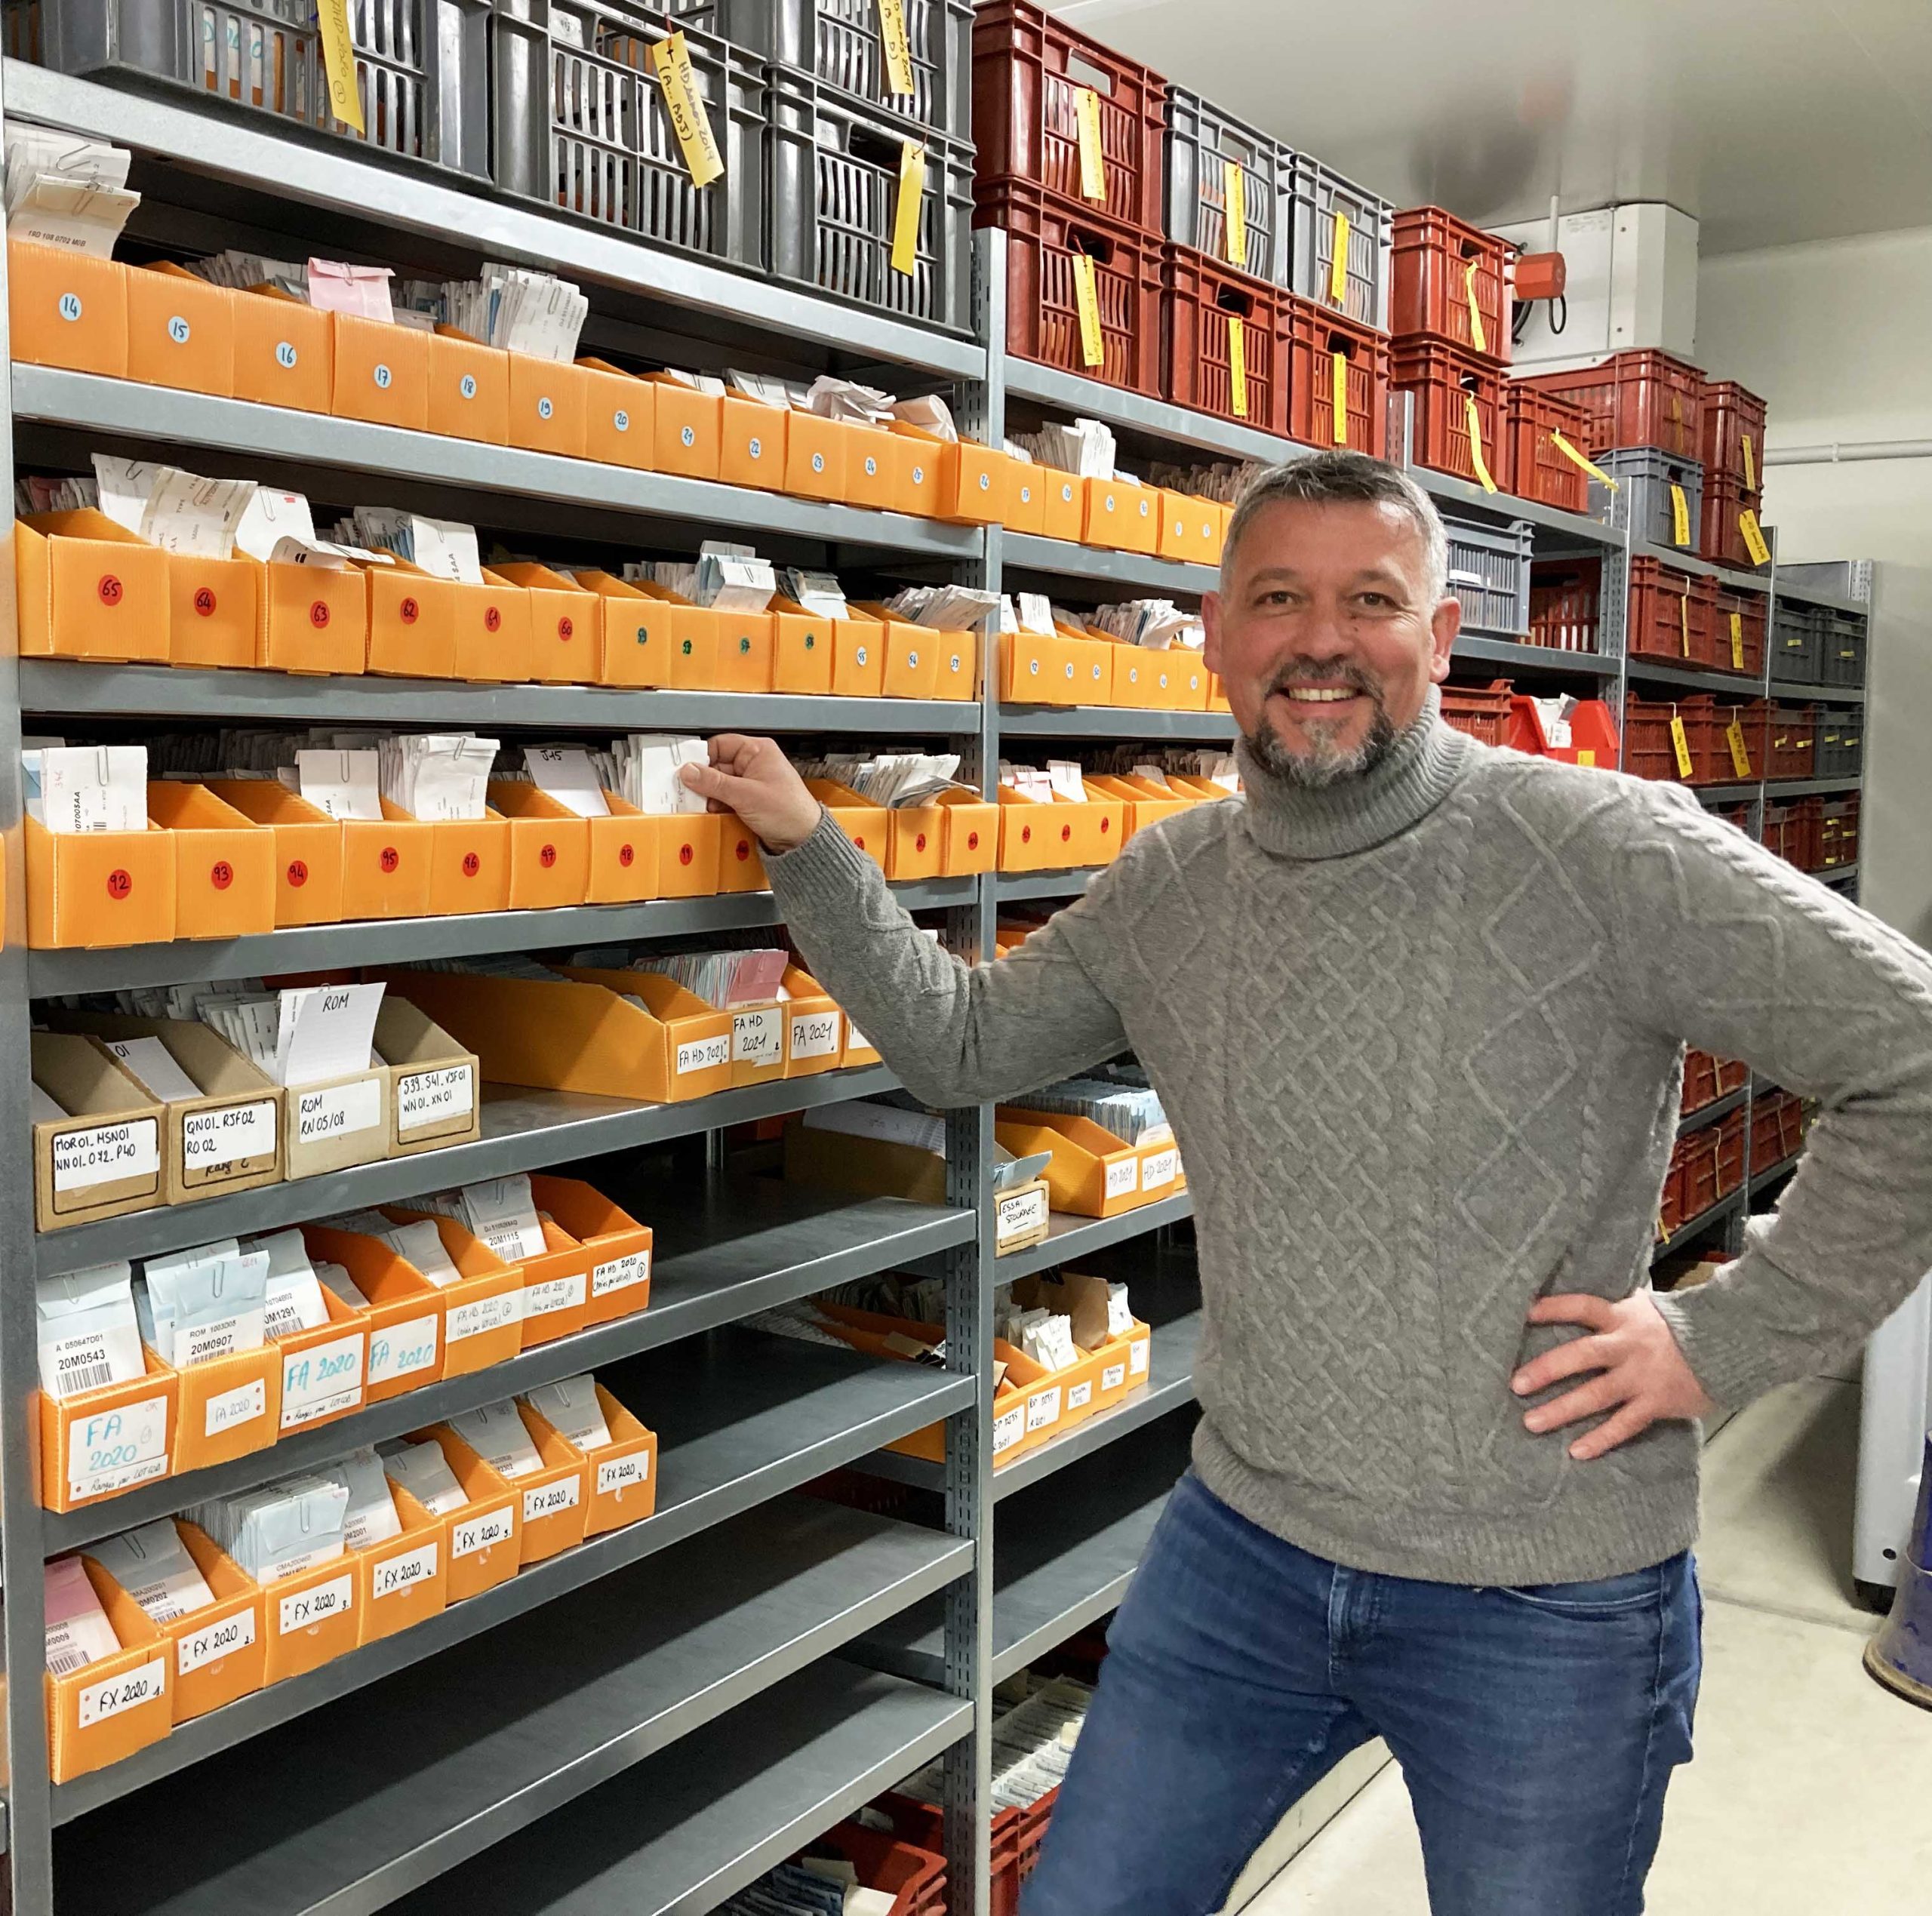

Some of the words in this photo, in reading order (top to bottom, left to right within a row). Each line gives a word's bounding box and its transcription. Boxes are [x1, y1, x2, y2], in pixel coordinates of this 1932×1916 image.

[678, 61, 690, 84] HD
[64, 296, 78, 317] 14
[173, 321, 188, 338] 15
[281, 346, 294, 364] 16
[377, 368, 389, 386] 17
[463, 378, 474, 394] 18
[540, 401, 551, 416] 19
[617, 412, 627, 426] 20
[683, 427, 693, 444] 21
[750, 441, 760, 454] 22
[814, 455, 823, 469] 23
[866, 460, 875, 473] 24
[913, 468, 922, 480] 25
[102, 580, 122, 597] 65
[196, 592, 211, 610] 64
[403, 599, 415, 618] 62
[313, 607, 328, 622] 63
[488, 609, 499, 626] 61
[561, 620, 572, 635] 60
[857, 650, 866, 662] 55
[909, 654, 917, 665] 54
[951, 658, 959, 668] 53
[382, 850, 396, 866] 95
[464, 855, 477, 869] 96
[541, 847, 555, 863] 97
[620, 848, 632, 861] 98
[681, 847, 691, 859] 99
[214, 865, 229, 881] 93
[288, 864, 305, 881] 94
[109, 874, 129, 891] 92
[322, 992, 350, 1013] ROM
[734, 1017, 746, 1032] FA
[749, 1014, 764, 1028] HD
[742, 1032, 768, 1052] 2021
[792, 1024, 807, 1047] FA
[809, 1020, 834, 1041] 2021
[679, 1050, 690, 1068] FA
[692, 1047, 705, 1063] HD
[706, 1044, 724, 1062] 2021
[301, 1094, 323, 1115] ROM
[595, 1266, 606, 1278] FA
[608, 1264, 617, 1274] HD
[621, 1257, 638, 1269] 2020
[189, 1328, 207, 1339] ROM
[190, 1334, 233, 1356] 20M0907
[58, 1349, 106, 1371] 20M0543
[369, 1339, 390, 1373] FA
[397, 1343, 434, 1369] 2020
[286, 1360, 310, 1392] FA
[315, 1352, 357, 1382] 2020
[215, 1407, 226, 1422] FA
[229, 1398, 251, 1416] 2020
[86, 1413, 122, 1447] FA
[88, 1444, 137, 1472] 2020
[606, 1468, 617, 1482] FX
[618, 1462, 635, 1478] 2020
[533, 1497, 545, 1512] FX
[546, 1489, 567, 1508] 2020
[462, 1530, 476, 1550] FX
[481, 1523, 500, 1542] 2020
[384, 1570, 398, 1589] FX
[400, 1561, 422, 1581] 2020
[294, 1600, 310, 1621] FX
[314, 1592, 336, 1612] 2020
[193, 1637, 208, 1659] FX
[213, 1624, 238, 1650] 2020
[99, 1687, 120, 1713] FX
[121, 1679, 149, 1704] 2020
